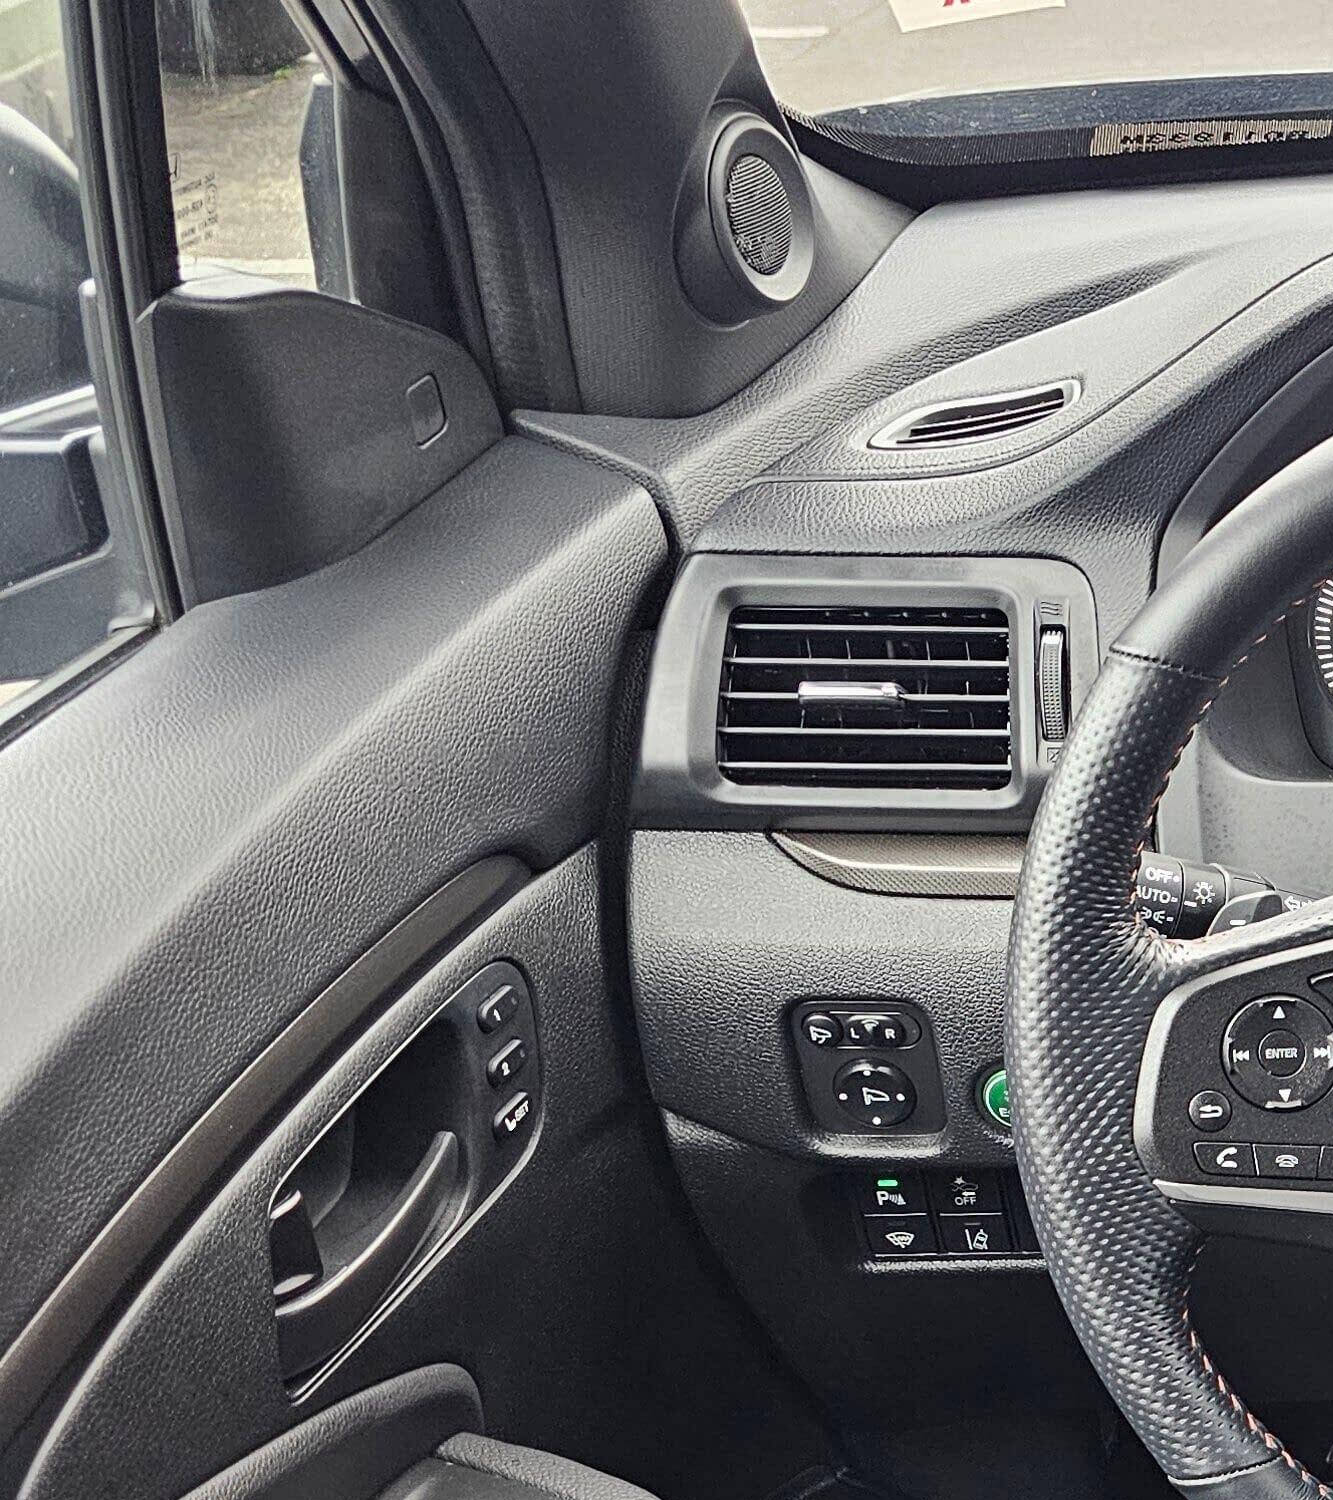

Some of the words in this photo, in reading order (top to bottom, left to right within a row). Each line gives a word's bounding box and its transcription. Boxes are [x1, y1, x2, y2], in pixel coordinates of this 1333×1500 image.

[1145, 866, 1174, 883] OFF
[850, 1028, 860, 1040] L
[884, 1028, 896, 1040] R
[1265, 1048, 1298, 1060] ENTER
[954, 1195, 977, 1207] OFF
